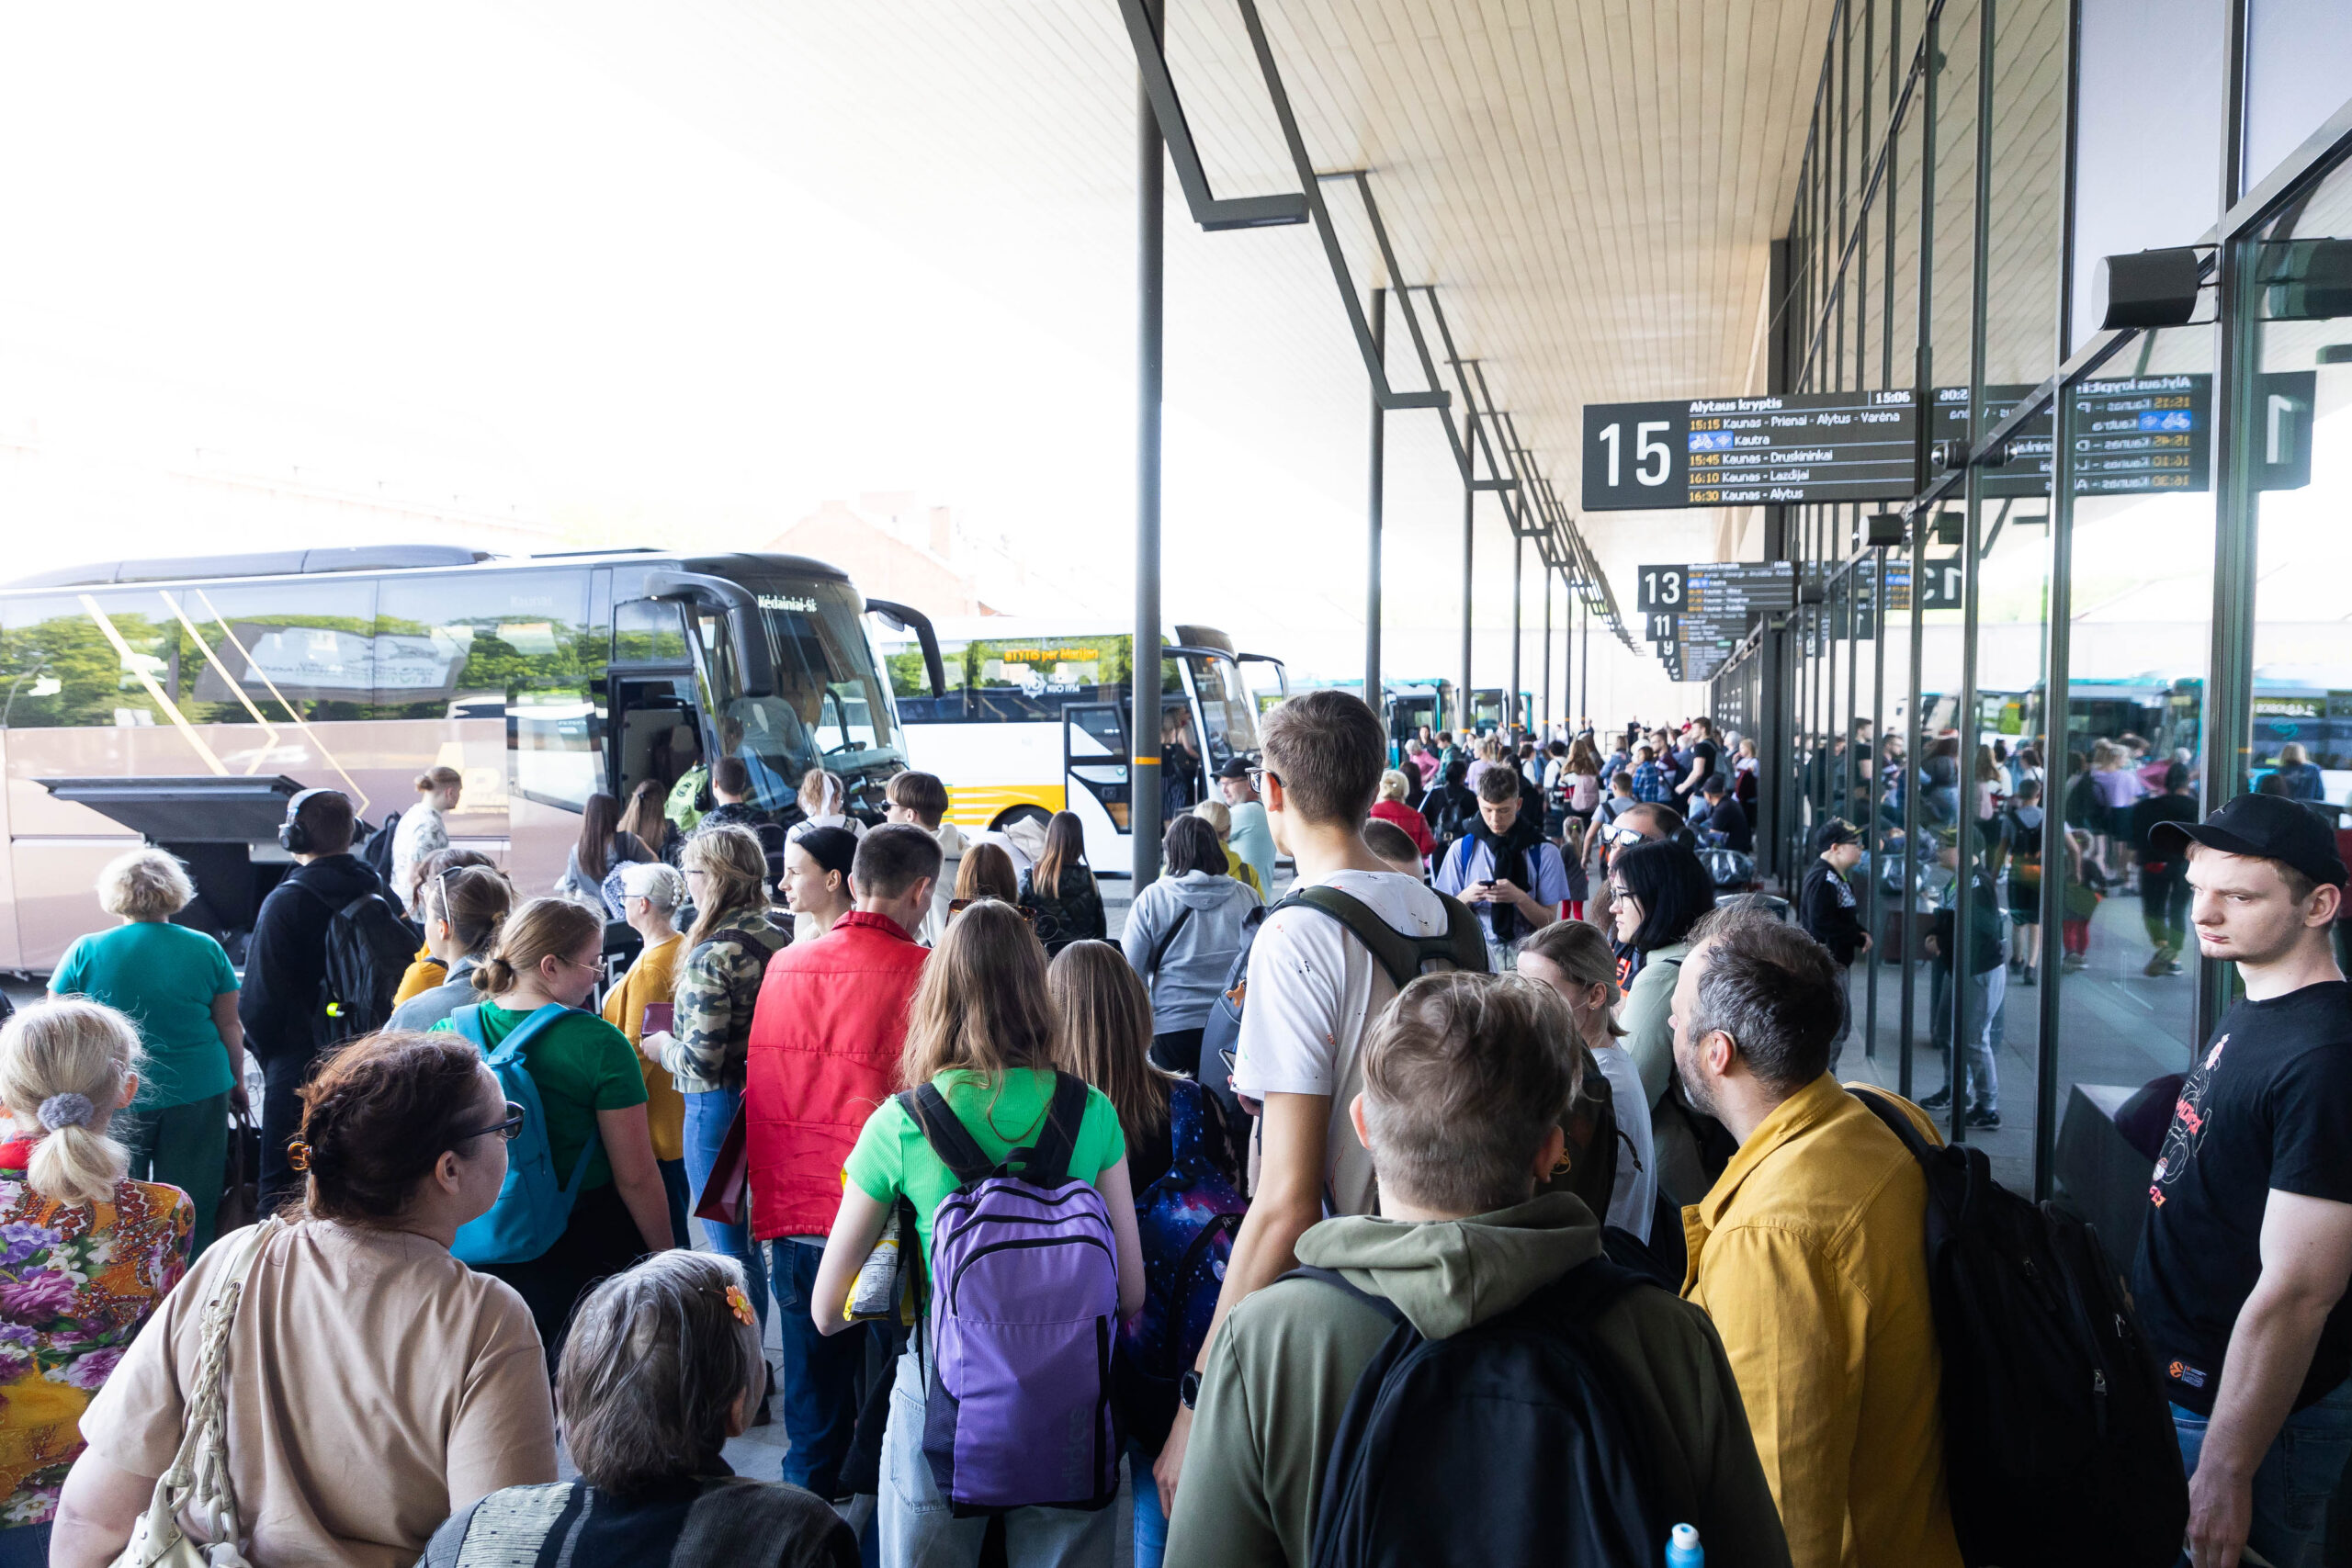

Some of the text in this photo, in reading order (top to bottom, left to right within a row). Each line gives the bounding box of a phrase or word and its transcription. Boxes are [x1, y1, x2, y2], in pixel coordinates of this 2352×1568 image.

[1875, 390, 1911, 404] 15:06
[1690, 398, 1782, 414] Alytaus kryptis
[1690, 418, 1720, 431] 15:15
[1723, 418, 1762, 430] Kaunas
[1770, 415, 1807, 427] Prienai
[1816, 412, 1851, 426] Alytus
[1734, 434, 1770, 446] Kautra
[1599, 421, 1671, 487] 15
[1690, 454, 1719, 467] 15:45
[1722, 454, 1761, 465] Kaunas
[1770, 449, 1833, 463] Druskininkai
[1690, 472, 1719, 484] 16:10
[1722, 472, 1760, 483] Kaunas
[1770, 469, 1810, 482] Lazdijai
[1690, 491, 1719, 502] 16:30
[1721, 490, 1760, 502] Kaunas
[1770, 488, 1804, 501] Alytus
[1645, 571, 1680, 604] 13
[1654, 615, 1670, 637] 11
